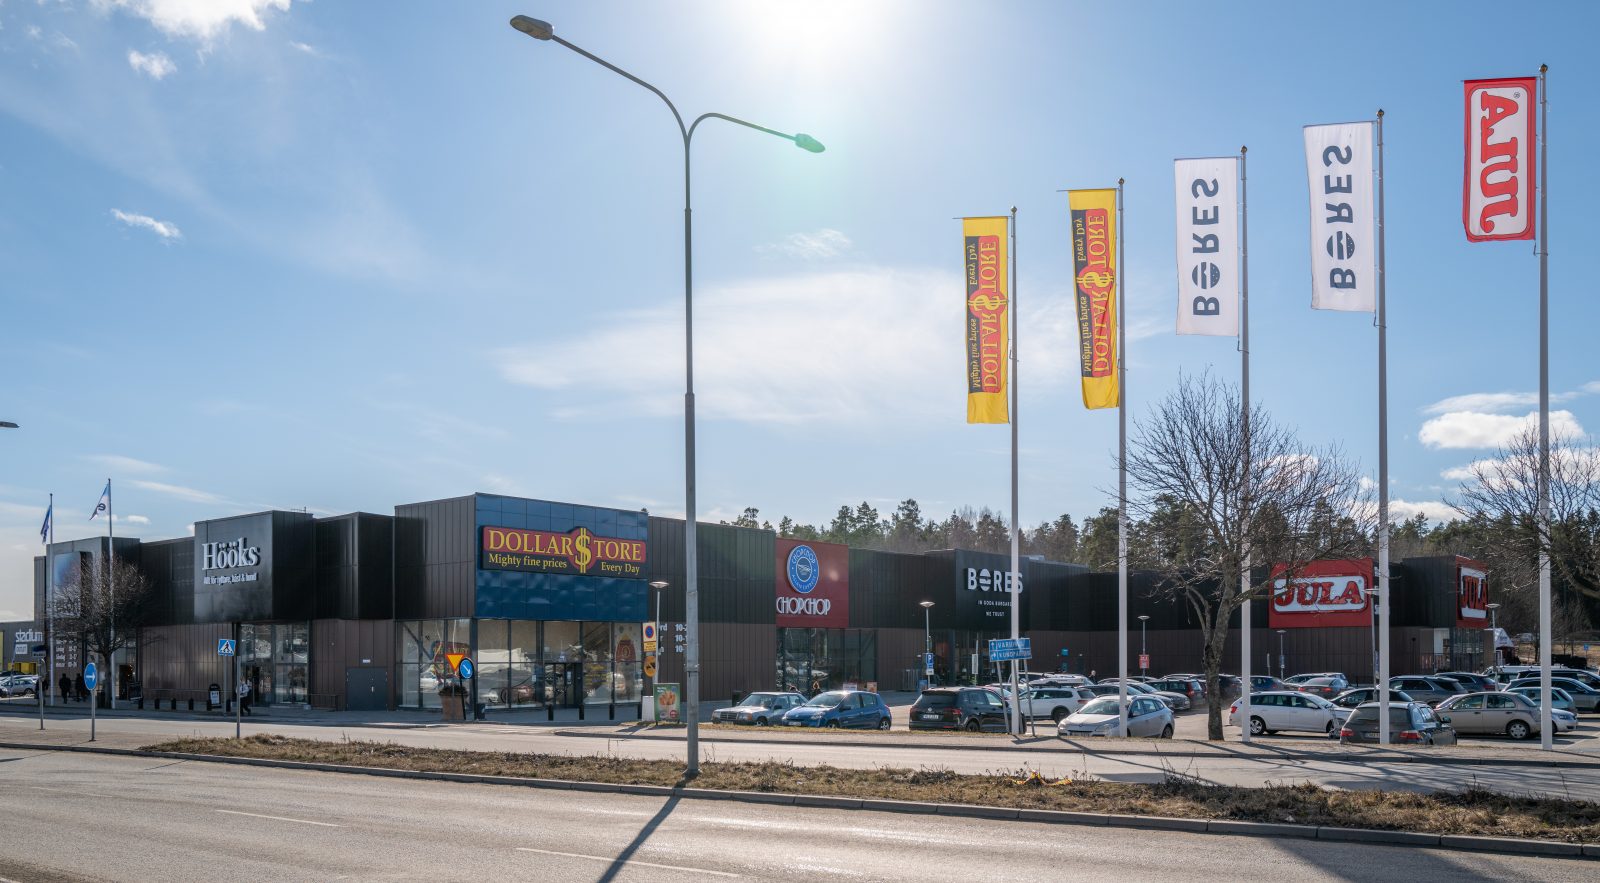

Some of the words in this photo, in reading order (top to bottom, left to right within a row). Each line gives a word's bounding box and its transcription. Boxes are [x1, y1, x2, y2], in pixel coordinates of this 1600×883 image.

[201, 537, 258, 571] Hööks
[488, 553, 521, 567] Mighty
[523, 555, 541, 566] fine
[542, 558, 567, 569] prices
[601, 561, 622, 575] Every
[624, 564, 640, 575] Day
[1274, 580, 1364, 607] JULA
[1460, 575, 1488, 610] JULA
[776, 596, 831, 615] CHOPCHOP
[15, 629, 43, 642] stadium
